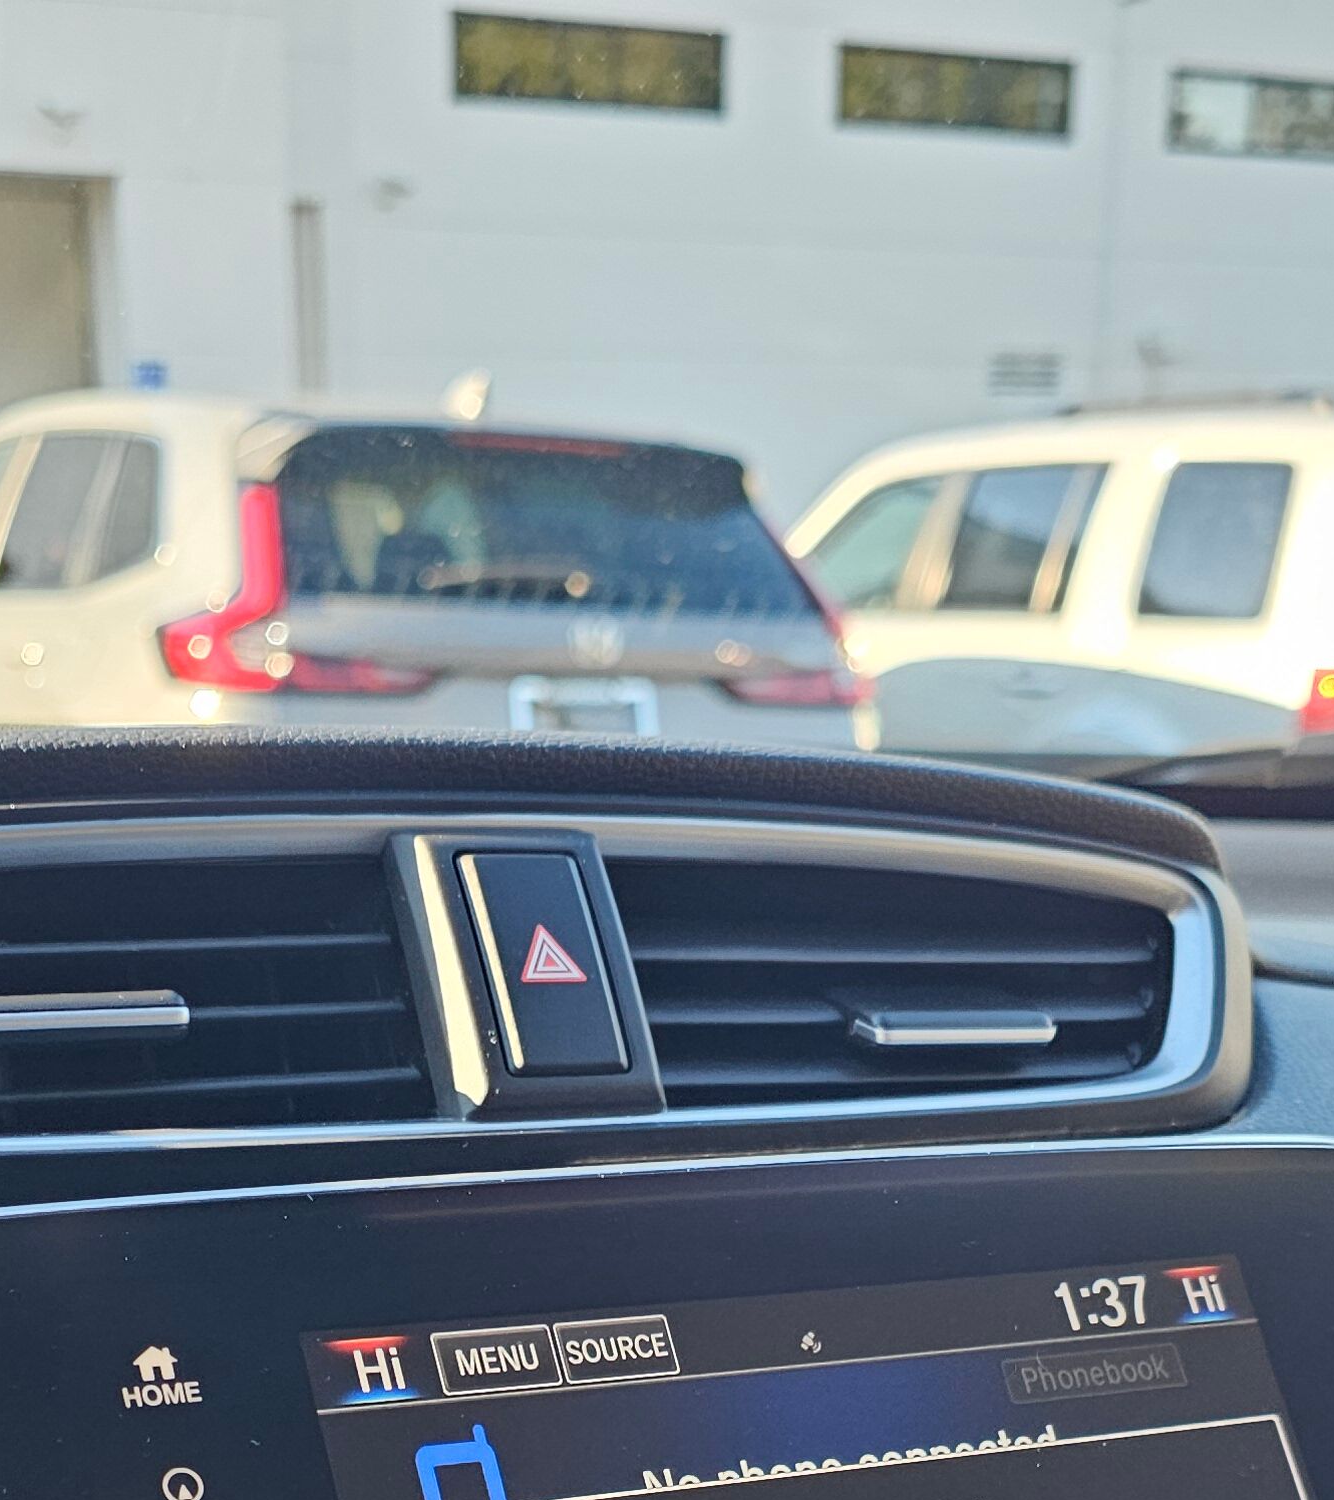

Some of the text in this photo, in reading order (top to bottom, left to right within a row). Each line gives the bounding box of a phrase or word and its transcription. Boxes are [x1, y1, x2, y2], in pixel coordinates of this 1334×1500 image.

[1054, 1274, 1148, 1332] 1:37
[1181, 1274, 1227, 1315] Hi
[454, 1342, 540, 1377] MENU
[564, 1332, 670, 1367] SOURCE
[353, 1347, 408, 1394] Hi
[1020, 1353, 1170, 1395] Phonebook
[121, 1380, 204, 1409] HOME
